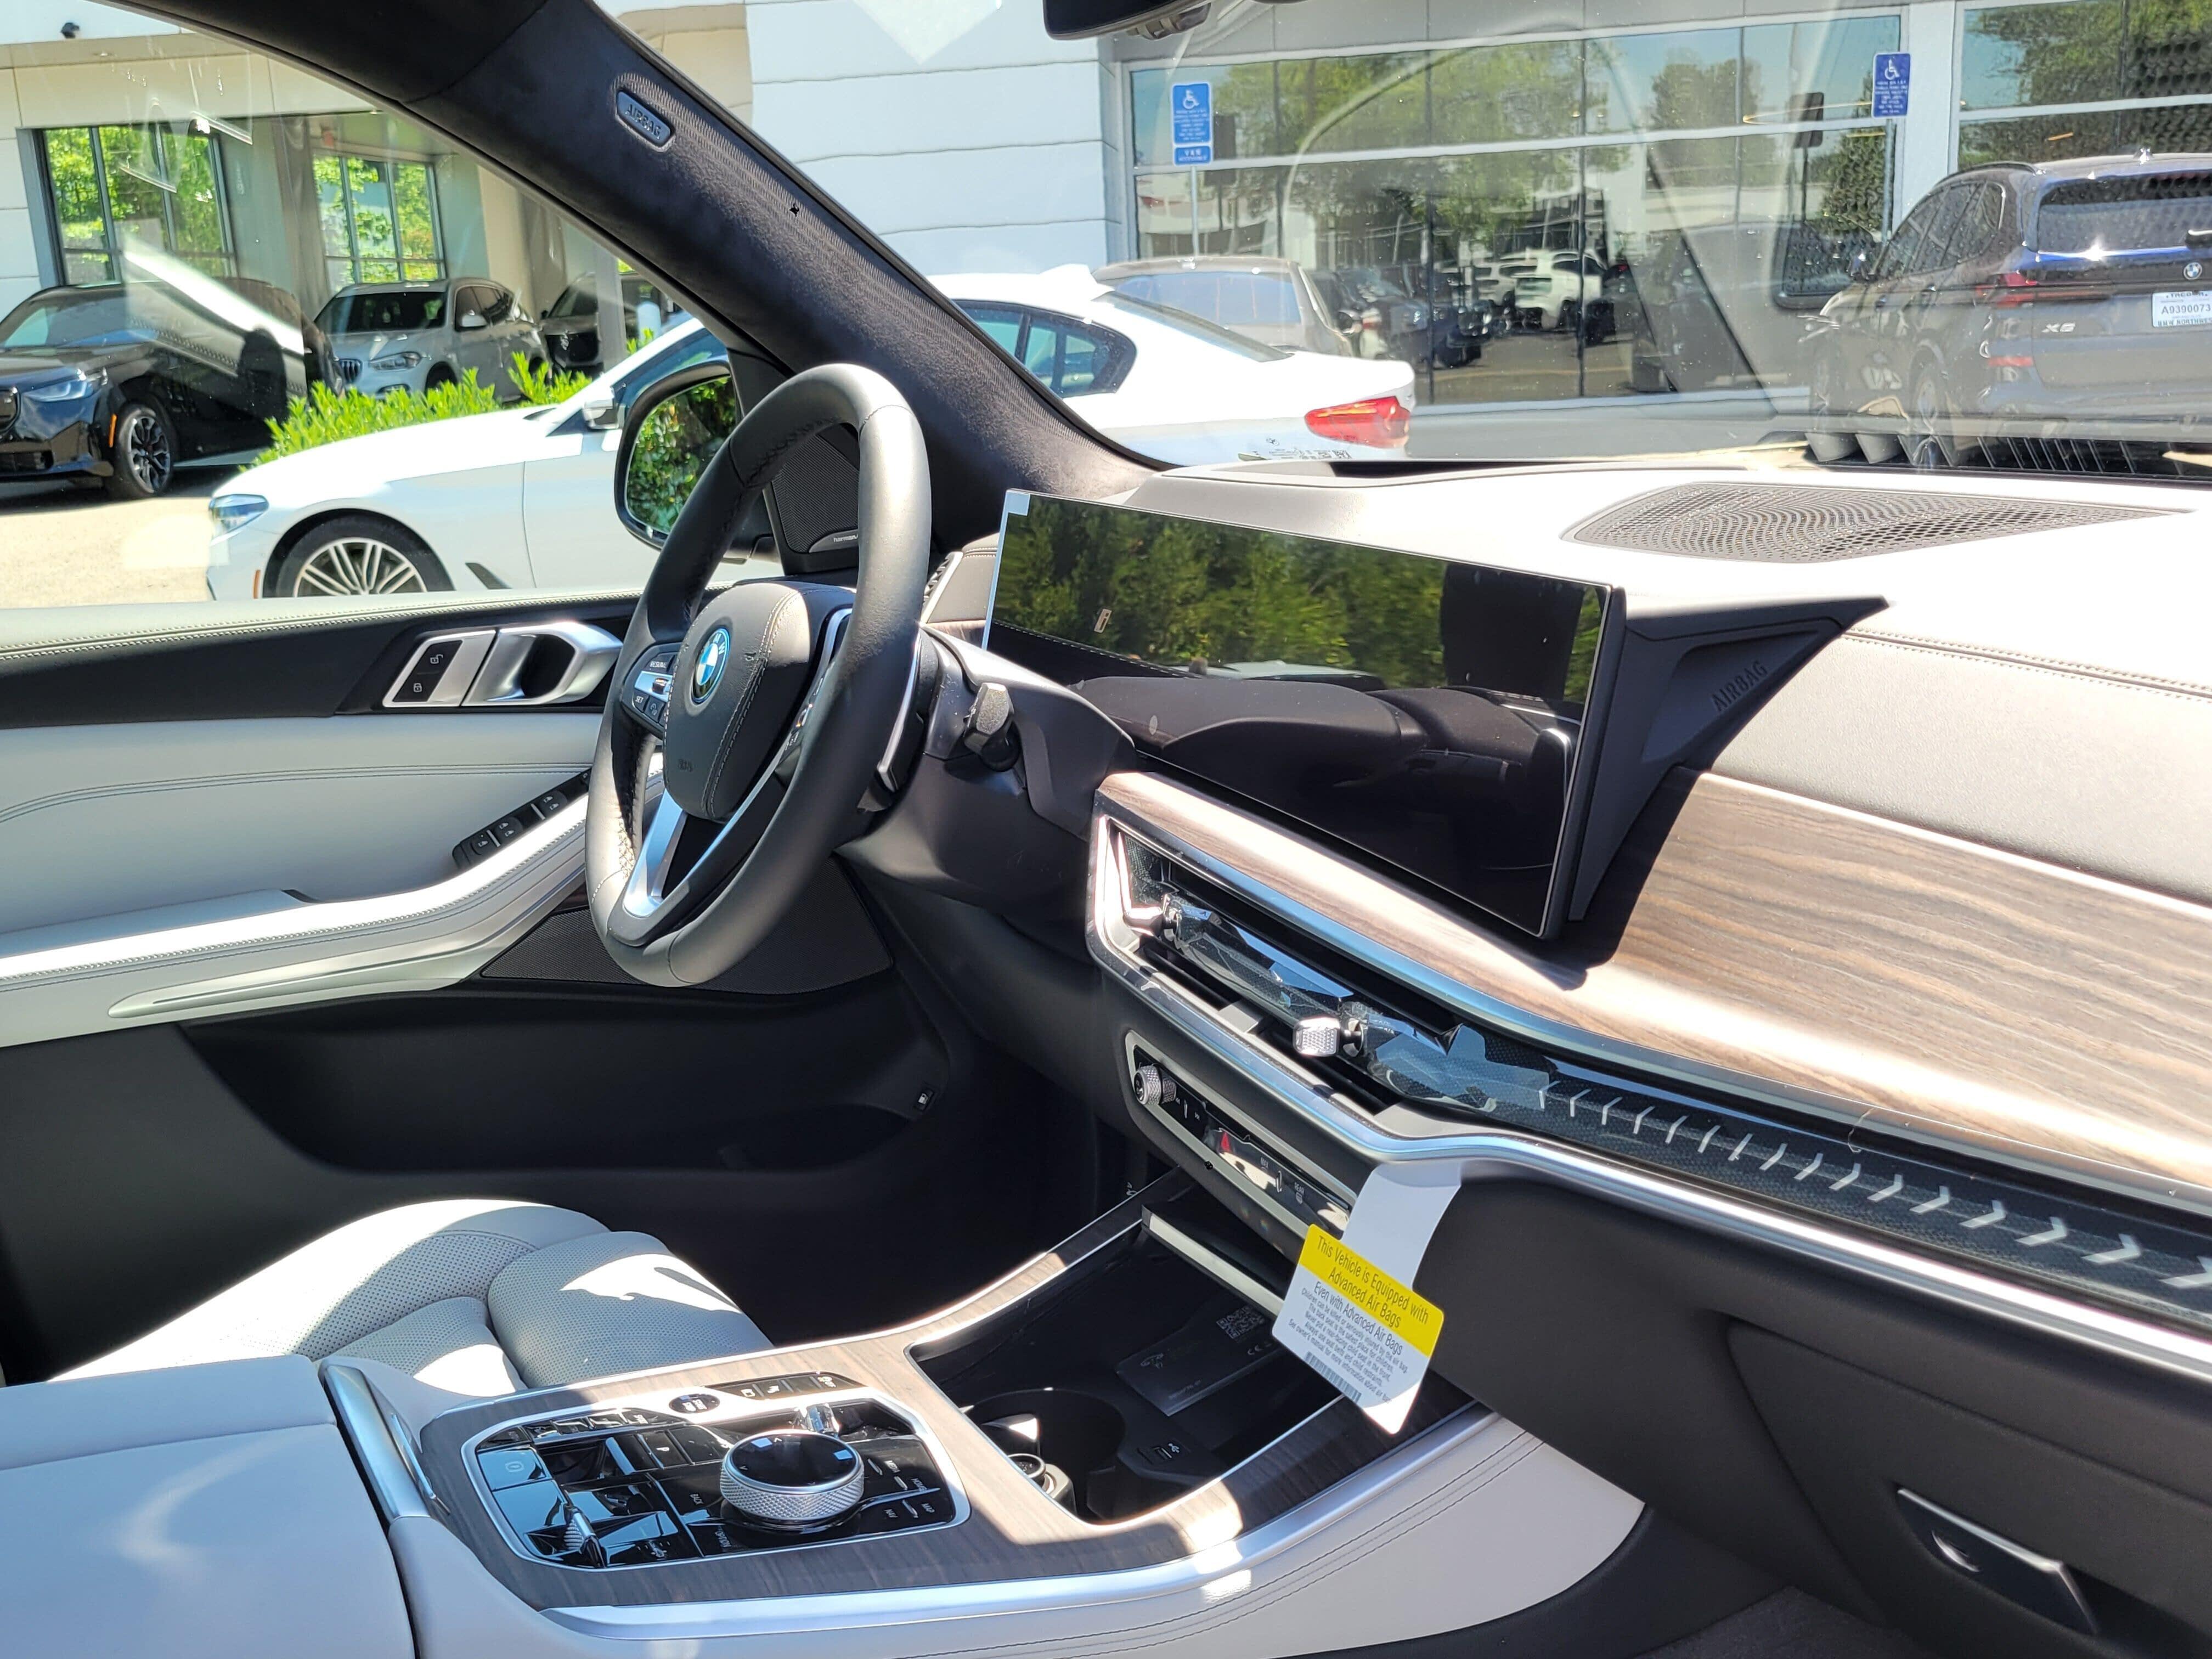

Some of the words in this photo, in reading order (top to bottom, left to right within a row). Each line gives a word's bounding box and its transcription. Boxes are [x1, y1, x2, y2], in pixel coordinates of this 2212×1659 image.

[625, 104, 661, 138] AIRBAG
[635, 696, 644, 704] SET
[1711, 661, 1767, 712] AIRBAG
[1317, 1235, 1333, 1258] This
[1335, 1246, 1361, 1277] Vehicle
[1362, 1266, 1369, 1283] is
[1370, 1273, 1409, 1311] Equipped
[1410, 1303, 1429, 1325] with
[1328, 1267, 1366, 1304] Advanced
[1366, 1294, 1380, 1313] Air
[1380, 1302, 1401, 1328] Bags
[1314, 1281, 1329, 1301] Even
[1329, 1295, 1344, 1312] with
[1344, 1303, 1375, 1334] Advanced
[1374, 1322, 1386, 1342] Air
[1385, 1333, 1403, 1356] Bags
[690, 1493, 704, 1505] BACK
[921, 1503, 935, 1513] MAP
[714, 1531, 732, 1548] OPTION
